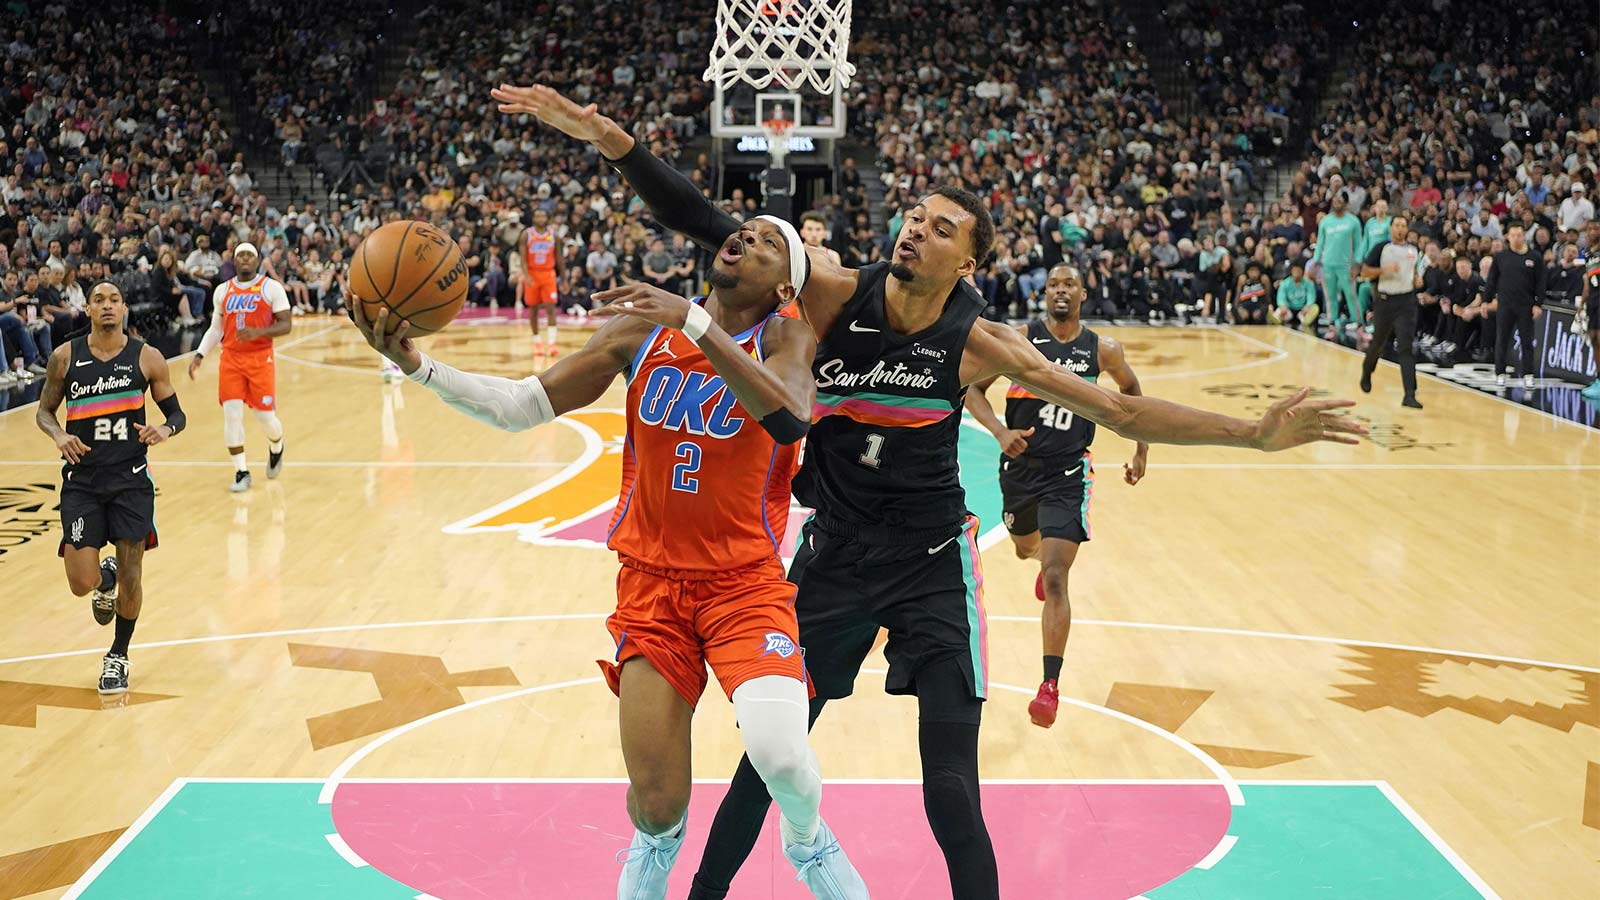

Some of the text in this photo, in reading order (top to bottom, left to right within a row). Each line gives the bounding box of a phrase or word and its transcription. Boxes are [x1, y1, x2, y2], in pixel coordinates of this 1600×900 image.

[226, 294, 262, 313] OKC
[916, 347, 942, 359] LEDGER
[1548, 321, 1585, 374] JACK
[70, 375, 132, 400] San Antonio
[816, 358, 938, 389] San Antonio
[638, 365, 746, 440] OKC
[1039, 403, 1074, 431] 40
[94, 417, 129, 441] 24
[859, 432, 885, 469] 1
[671, 441, 703, 495] 2
